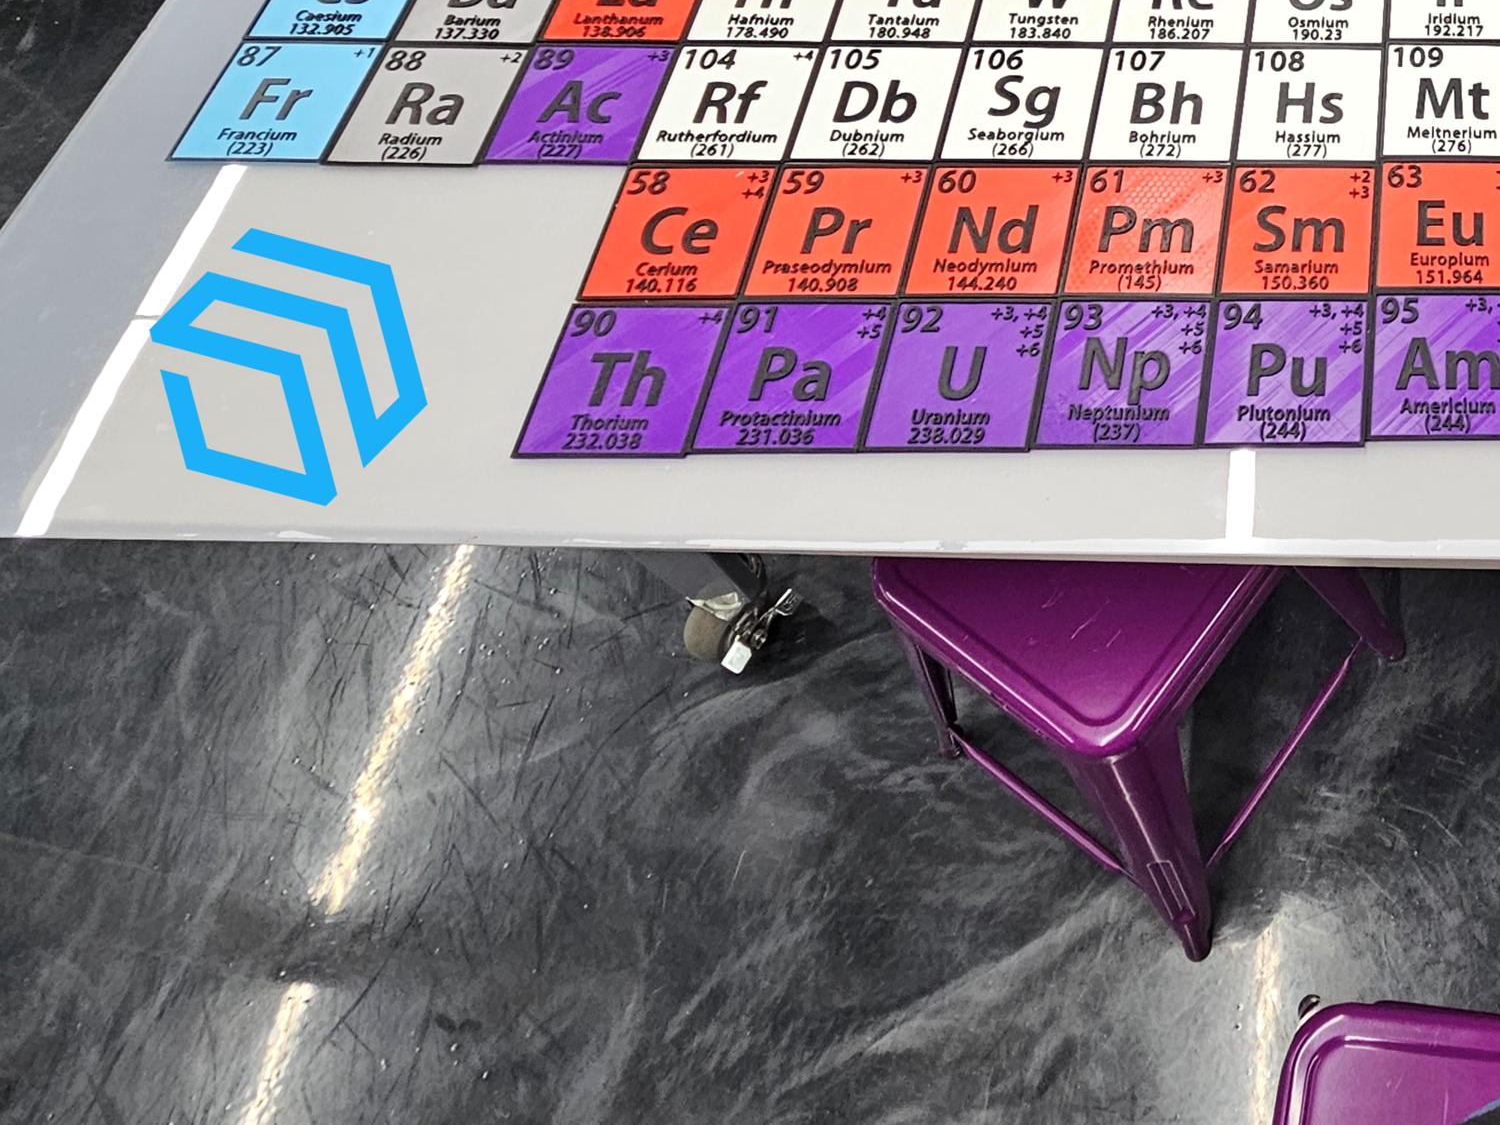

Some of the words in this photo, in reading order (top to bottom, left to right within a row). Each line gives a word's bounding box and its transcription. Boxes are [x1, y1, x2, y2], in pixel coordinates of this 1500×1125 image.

[443, 14, 501, 27] Barium
[728, 14, 794, 26] Hafnium
[1009, 13, 1079, 28] Tungsten
[1148, 15, 1214, 28] Rhenium
[435, 27, 500, 40] 137.330
[727, 26, 789, 39] 178.490
[1011, 27, 1071, 39] 183.840
[1150, 28, 1210, 40] 186.207
[236, 46, 282, 67] 87
[685, 49, 737, 70] 104
[831, 48, 882, 70] 105
[239, 78, 314, 121] Fr
[692, 80, 768, 124] Rf
[832, 79, 917, 123] Db
[1276, 82, 1343, 124] Hs
[217, 127, 298, 141] Francium
[656, 129, 778, 143] Rutherfordium
[829, 129, 905, 143] Dubnium
[226, 141, 274, 157] (223)
[690, 143, 734, 158] (261)
[842, 142, 885, 158] (262)
[626, 170, 671, 195] 58
[938, 170, 977, 194] 60
[641, 207, 719, 255] Ce
[947, 204, 1040, 254] Nd
[1416, 200, 1484, 247] Eu
[635, 262, 698, 276] Cerium
[933, 258, 1037, 276] Neodymium
[626, 278, 698, 293] 140.116
[948, 275, 1017, 291] 144.240
[736, 306, 779, 334] 91
[901, 306, 944, 333] 92
[747, 347, 832, 402] Pa
[938, 346, 988, 401] U
[718, 409, 842, 427] Protactinium
[911, 408, 991, 426] Uranium
[735, 427, 816, 446] 231.036
[907, 426, 986, 445] 238.029
